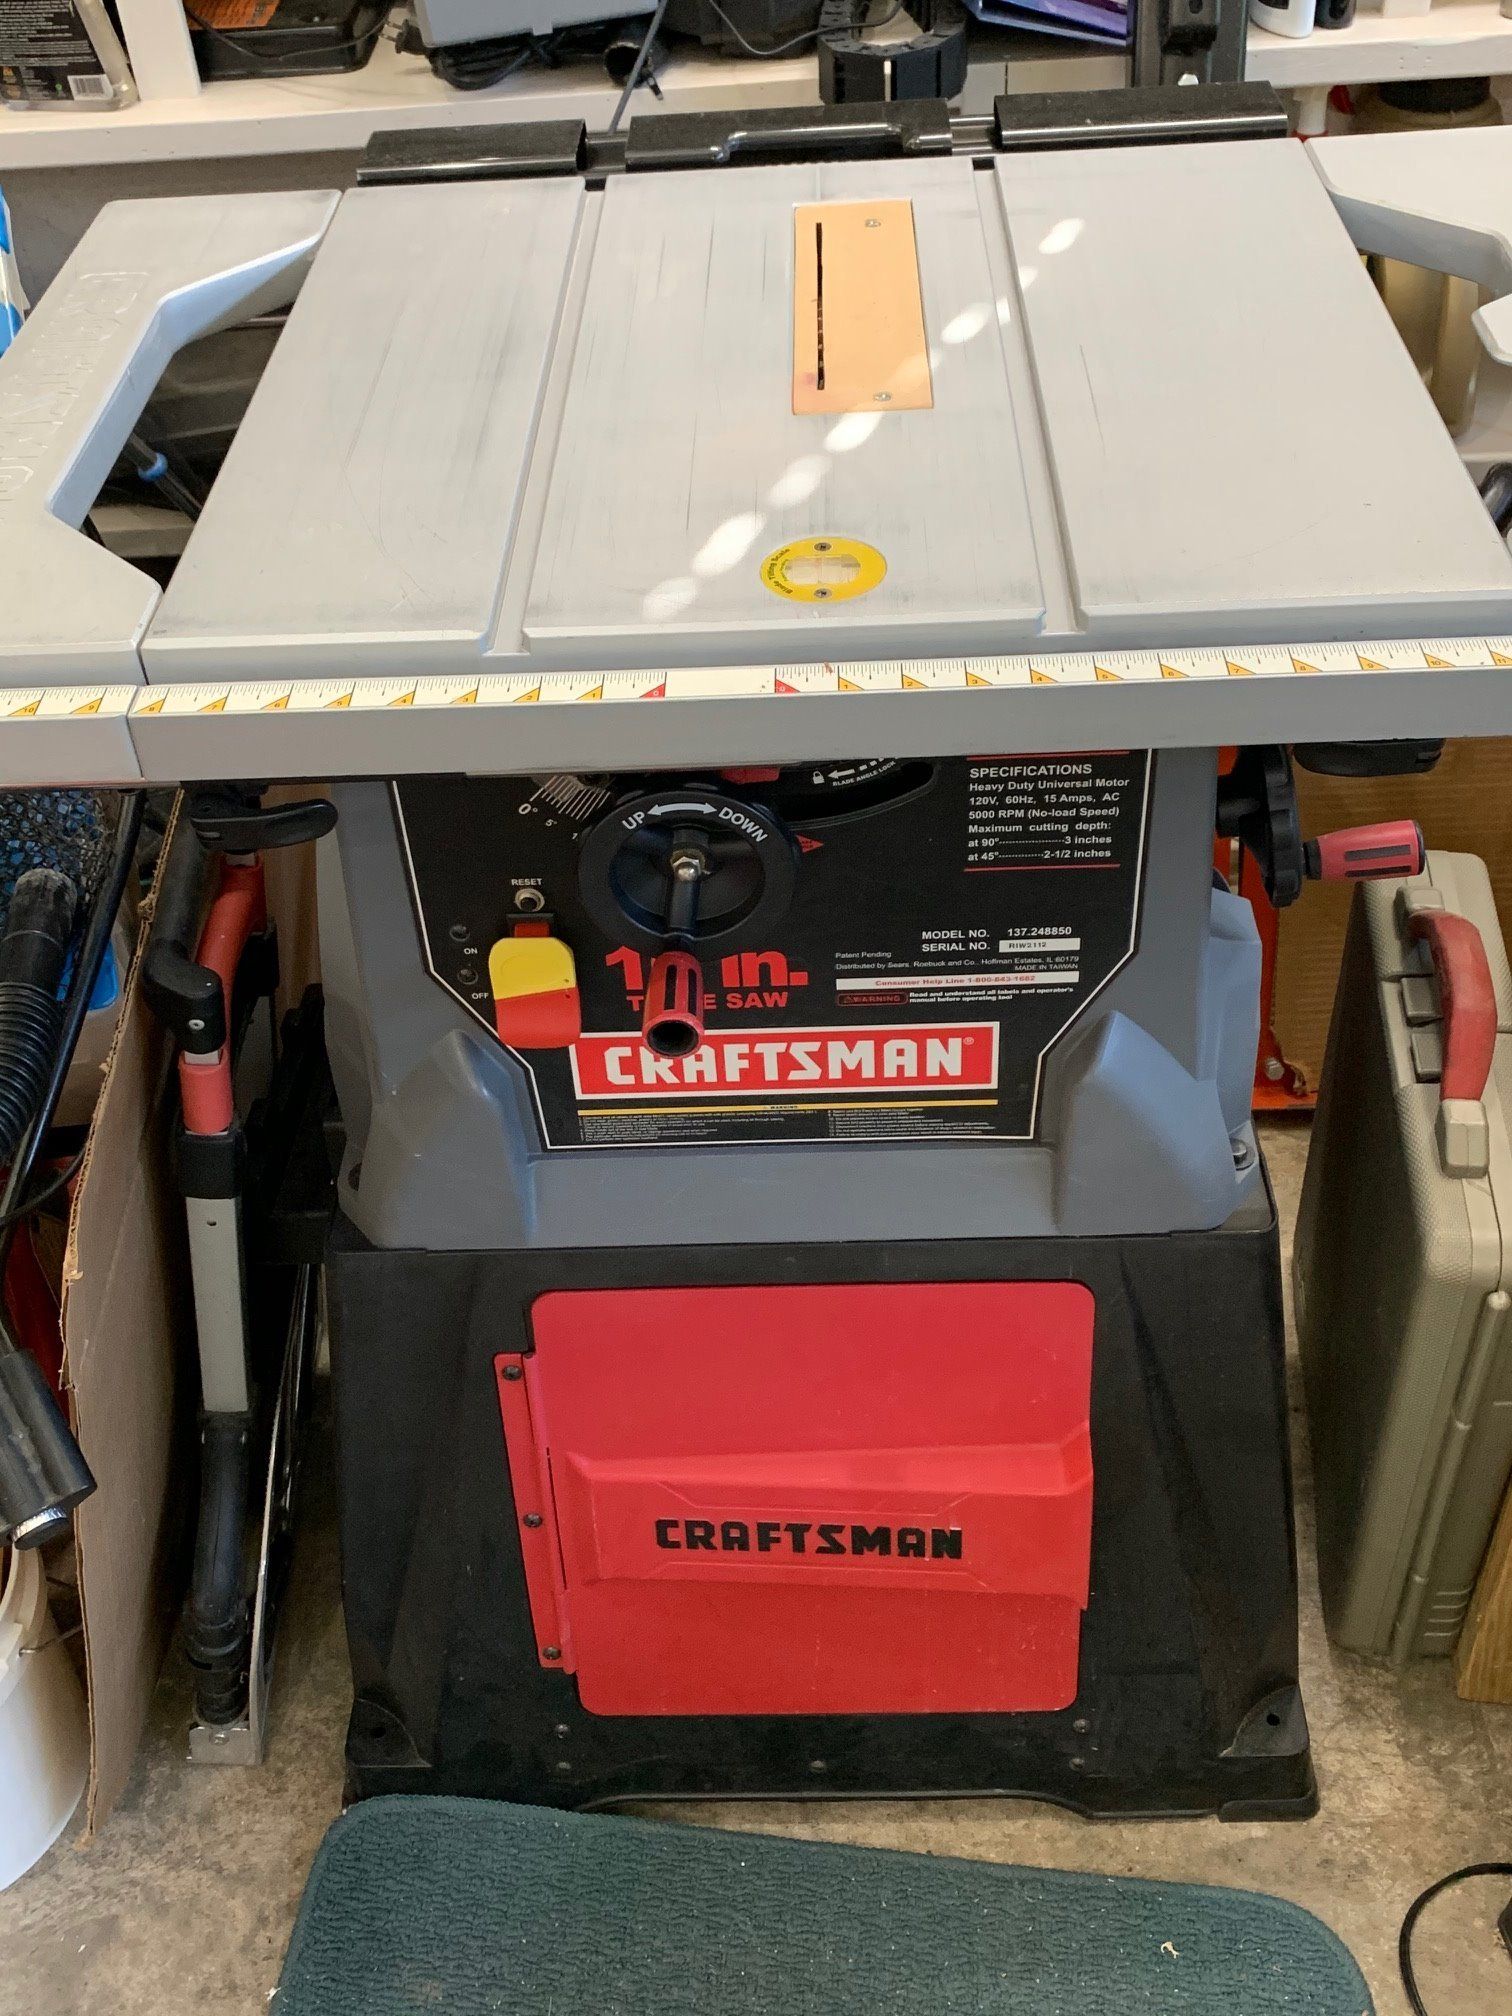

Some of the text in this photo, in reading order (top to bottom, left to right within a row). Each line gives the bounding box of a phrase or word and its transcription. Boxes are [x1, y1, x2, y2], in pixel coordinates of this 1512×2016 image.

[832, 778, 855, 787] BLADE
[877, 760, 896, 772] LOCK
[969, 763, 1093, 779] SPECIFICATIONS
[969, 778, 1129, 793] Heavy Duty Universal Motor
[970, 792, 1120, 806] 120V, 60Hz, 15 Amps, AC
[968, 807, 1120, 819] 5000 RPM (No-load Speed)
[621, 810, 648, 831] UP
[717, 806, 769, 843] DOWN
[968, 821, 1112, 833] Maximum cutting depth:
[968, 839, 979, 848] at
[1074, 835, 1112, 844] inches
[968, 853, 979, 862] at
[1043, 850, 1071, 859] 2-1/2
[1074, 849, 1112, 858] inches
[511, 878, 543, 886] RESET
[921, 926, 1072, 940] MODEL NO. 137.248850
[463, 947, 478, 955] ON
[921, 942, 965, 953] SERIAL
[968, 941, 991, 951] NO.
[721, 950, 809, 988] in.
[876, 962, 886, 970] by
[471, 992, 489, 1000] OFF
[944, 989, 986, 997] understand
[726, 991, 789, 1009] SAW
[654, 1517, 964, 1560] CRAFTSMAN
